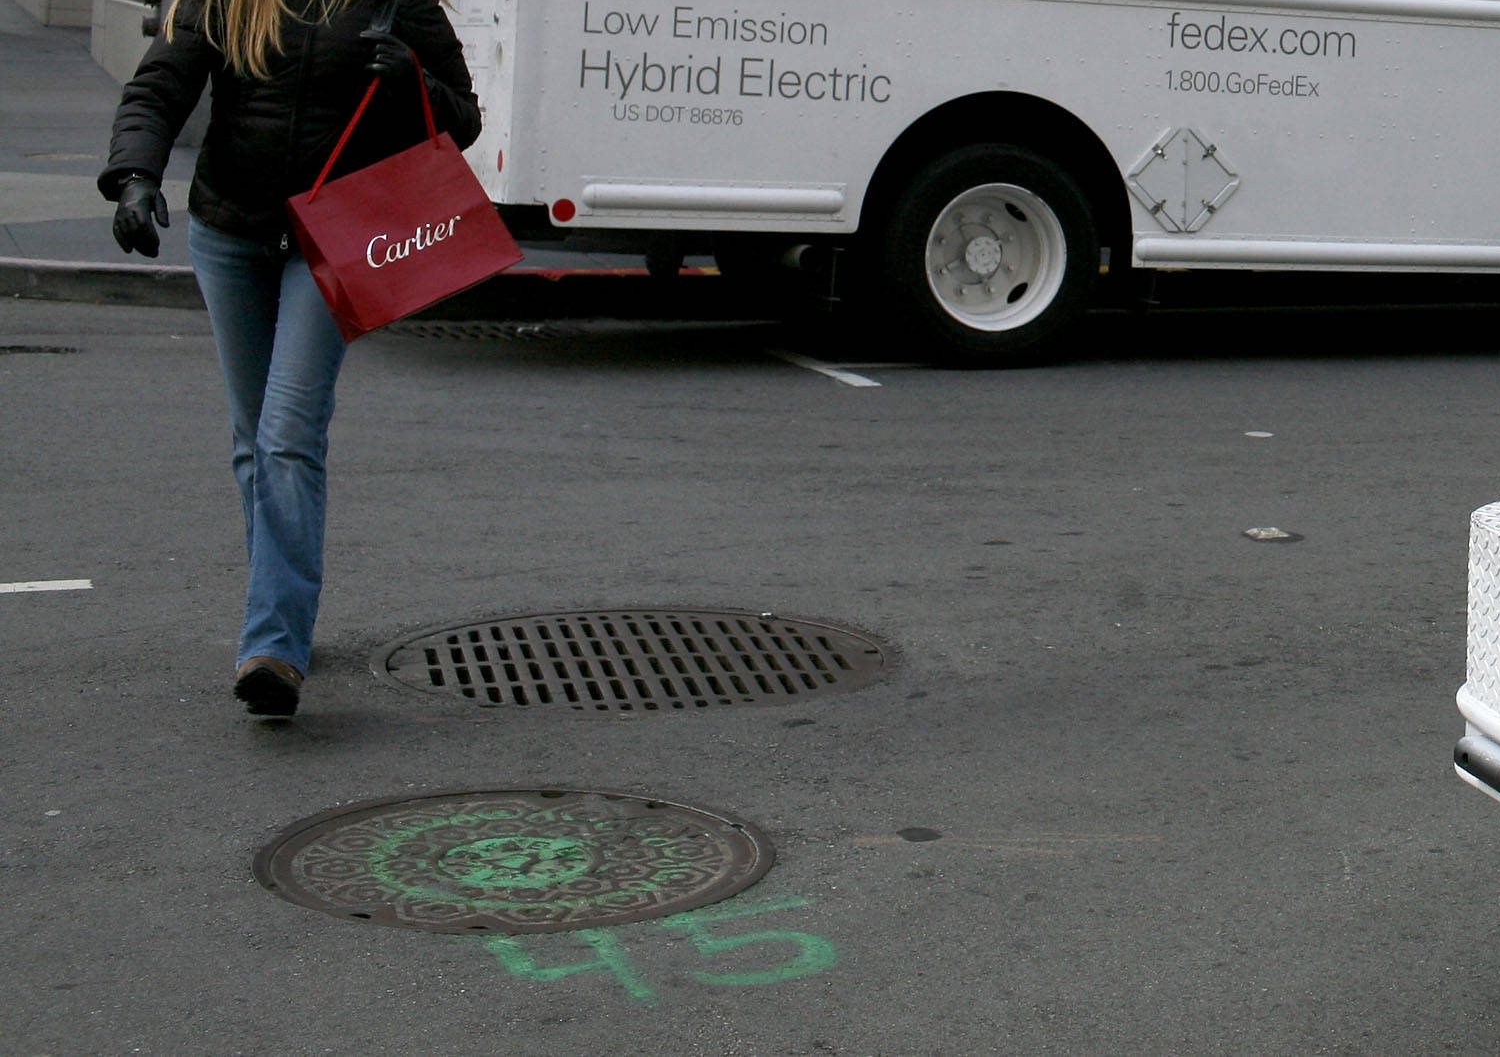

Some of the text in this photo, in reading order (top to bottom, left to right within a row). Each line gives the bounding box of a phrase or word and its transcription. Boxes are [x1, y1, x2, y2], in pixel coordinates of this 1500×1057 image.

[583, 0, 828, 46] Low Emission
[1167, 11, 1356, 58] fedex.com
[579, 48, 891, 104] Hybrid Electric
[1165, 69, 1321, 98] 1.800.GoFedEx
[612, 103, 744, 127] US DOT 86876
[366, 215, 462, 269] Cartier
